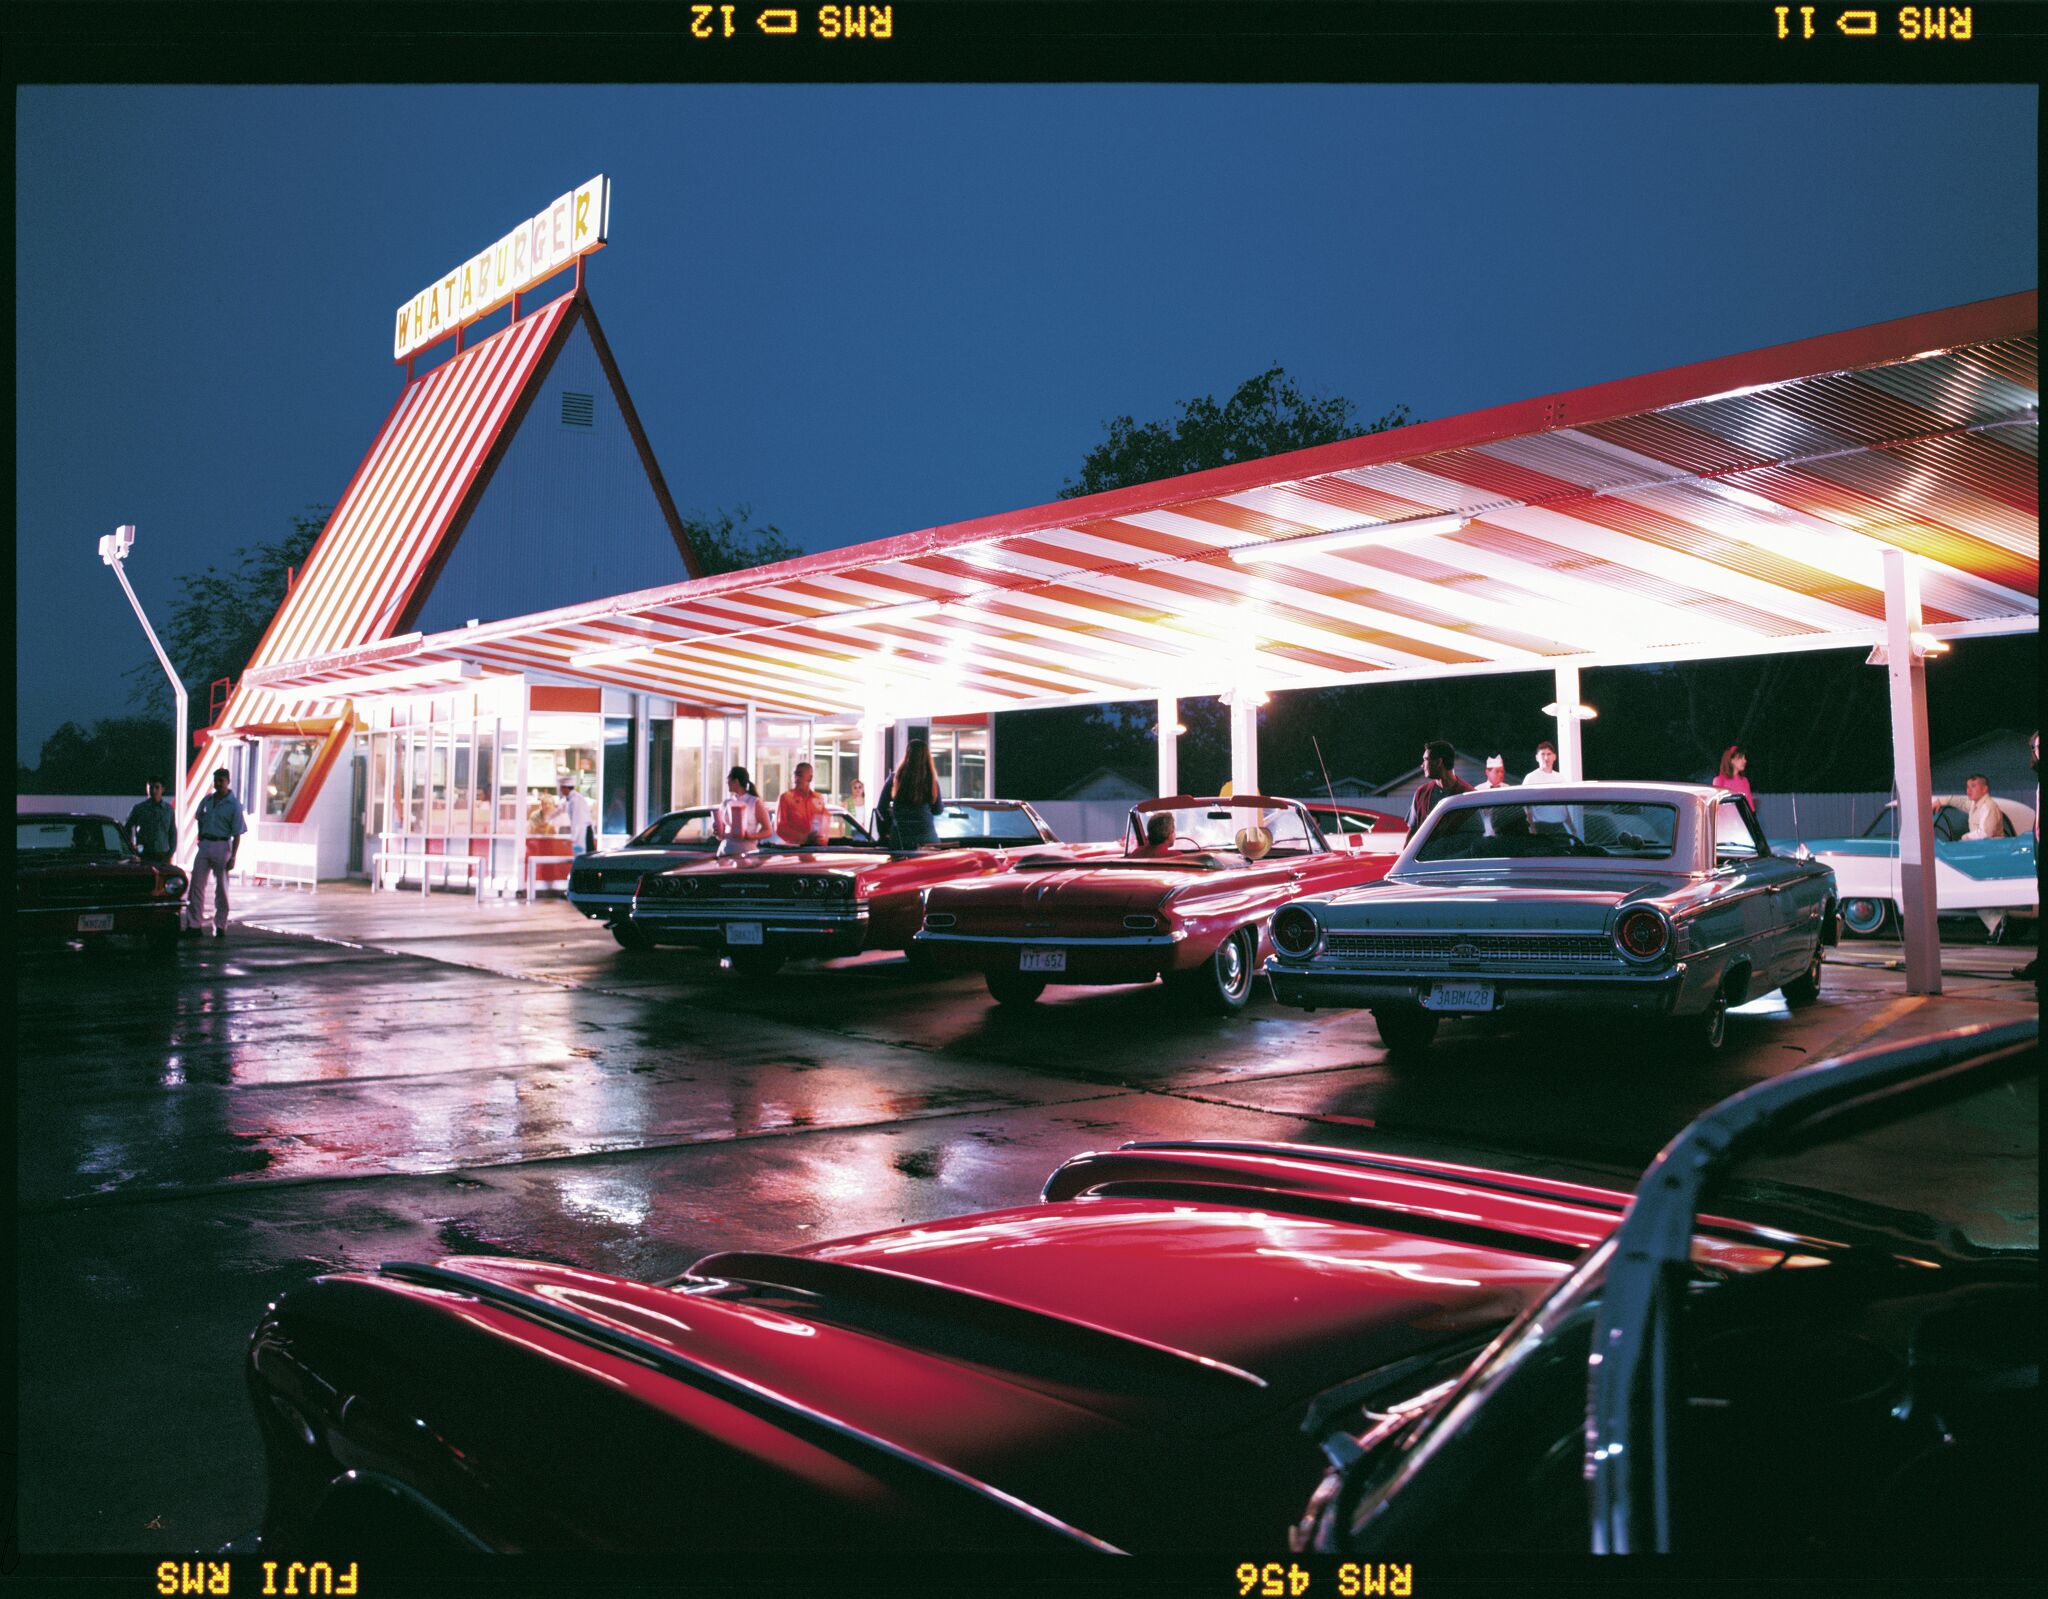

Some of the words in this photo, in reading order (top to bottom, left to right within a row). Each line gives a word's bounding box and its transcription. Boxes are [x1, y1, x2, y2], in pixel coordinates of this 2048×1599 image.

[691, 5, 735, 38] 12
[818, 5, 892, 38] RMS
[1774, 6, 1815, 39] 11
[1899, 6, 1972, 39] RMS
[399, 191, 590, 349] WHATABURGER
[157, 1562, 231, 1595] RMS
[262, 1562, 359, 1595] FUJI
[1236, 1563, 1310, 1596] 456
[1338, 1563, 1412, 1596] RMS
